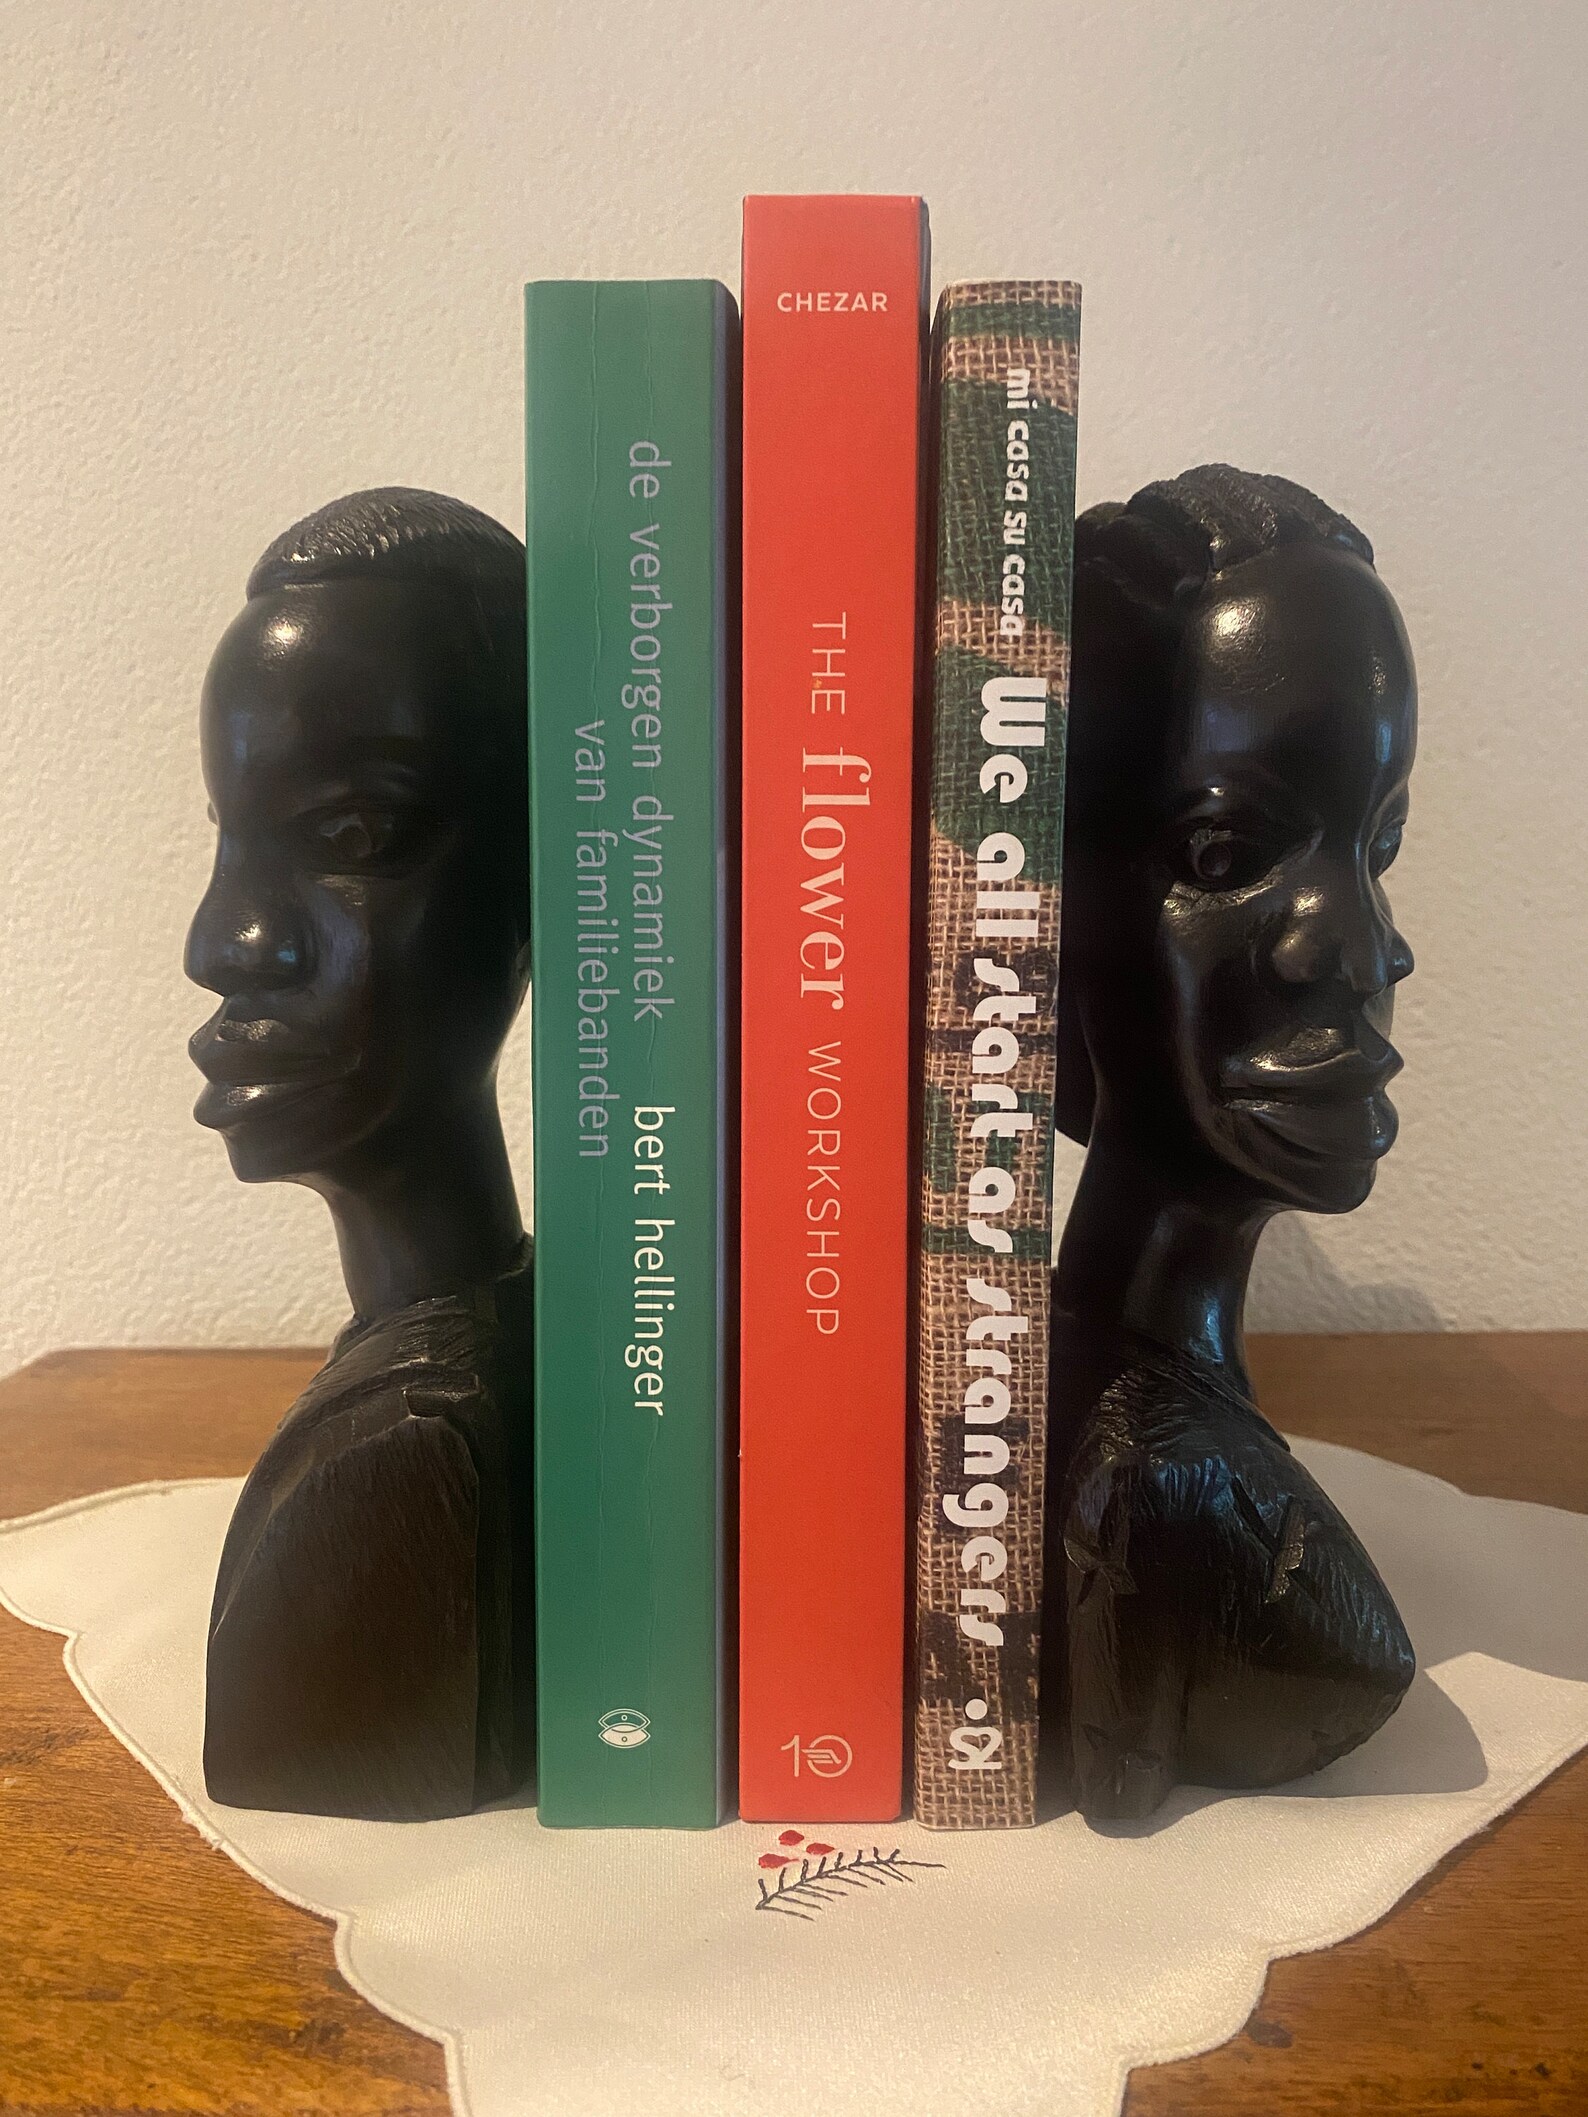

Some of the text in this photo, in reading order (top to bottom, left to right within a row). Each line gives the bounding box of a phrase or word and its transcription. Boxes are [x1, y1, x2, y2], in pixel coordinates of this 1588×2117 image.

[776, 291, 888, 312] CHEZAR
[1000, 368, 1037, 636] mi casa su casa
[575, 720, 621, 1157] van familiebanden
[621, 440, 675, 1021] de verborgen dynamiek
[800, 611, 873, 1335] THE flower WORKSHOP
[942, 676, 1047, 1647] We all start as strangers
[624, 1106, 676, 1416] bert hellinger
